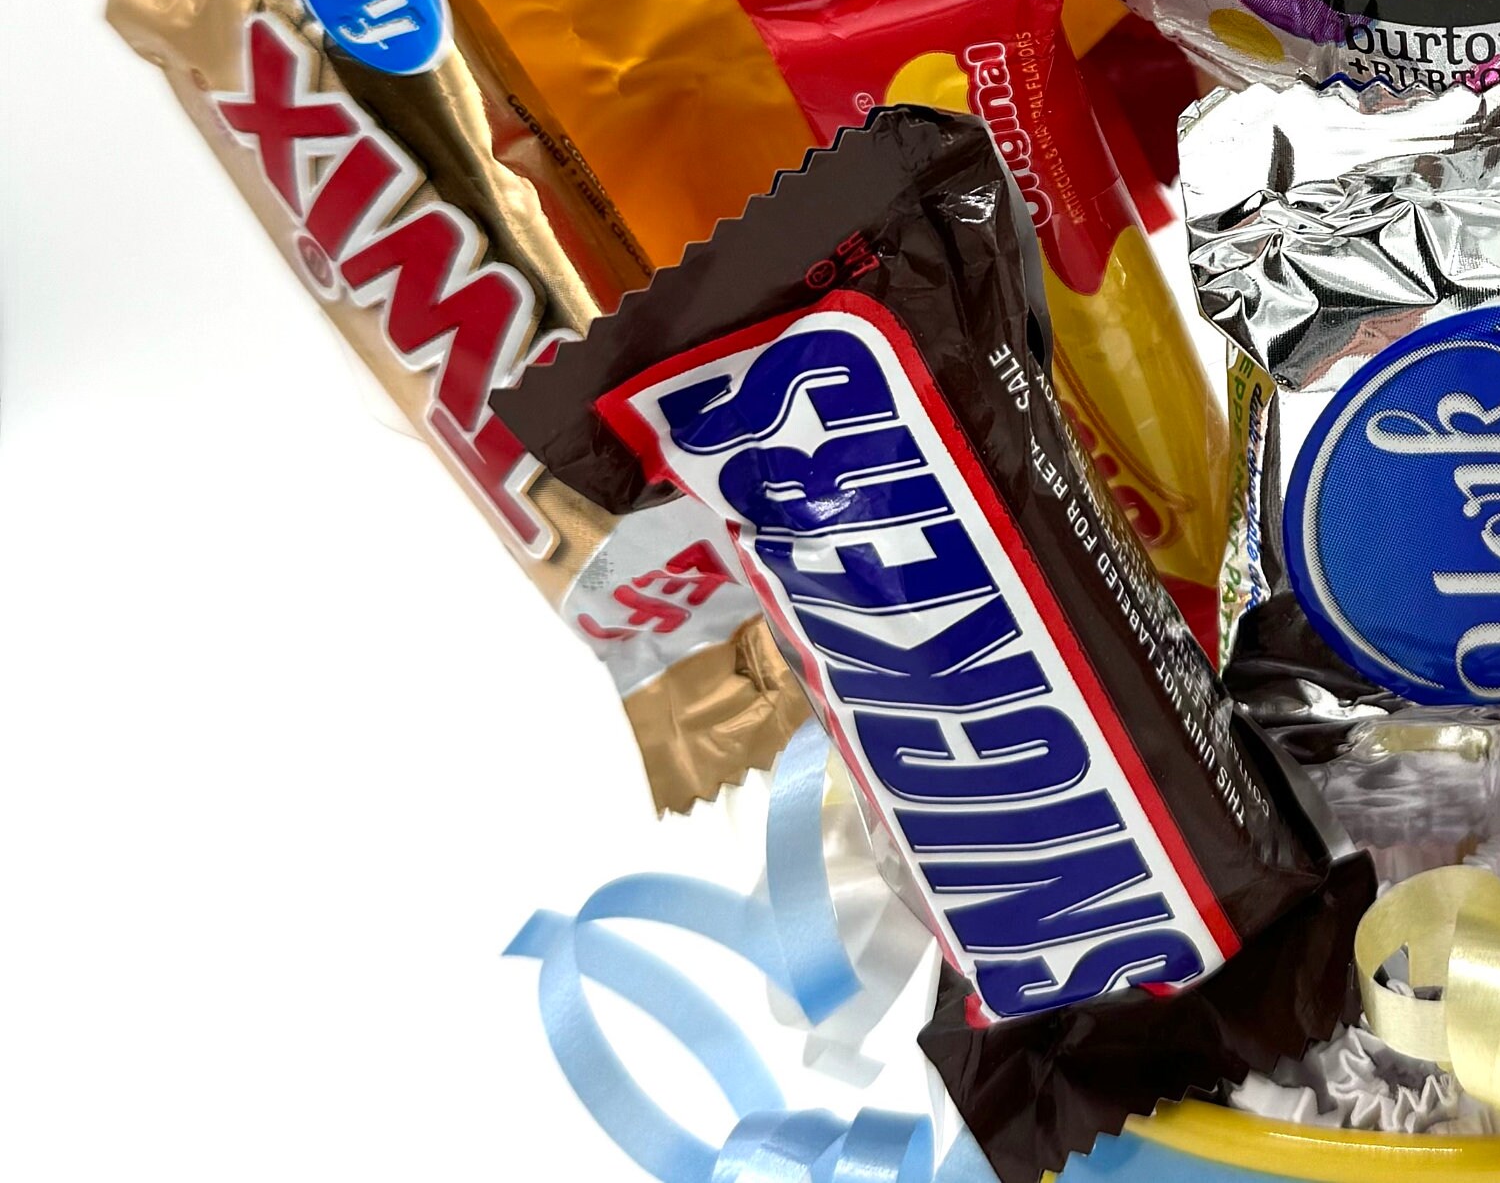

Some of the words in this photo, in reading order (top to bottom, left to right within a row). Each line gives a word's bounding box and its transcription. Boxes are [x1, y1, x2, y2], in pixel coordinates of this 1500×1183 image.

[1008, 29, 1048, 91] FLAVORS
[1047, 156, 1087, 226] ARTIFICIAL
[987, 342, 1032, 411] SALE
[1028, 431, 1069, 500] RETA
[1064, 497, 1099, 552] FOR
[1093, 551, 1161, 660] LABELED
[655, 328, 1206, 1018] SNICKERS
[1153, 659, 1184, 711] NOT
[1181, 711, 1217, 768] UNIT
[1214, 766, 1245, 825] THIS
